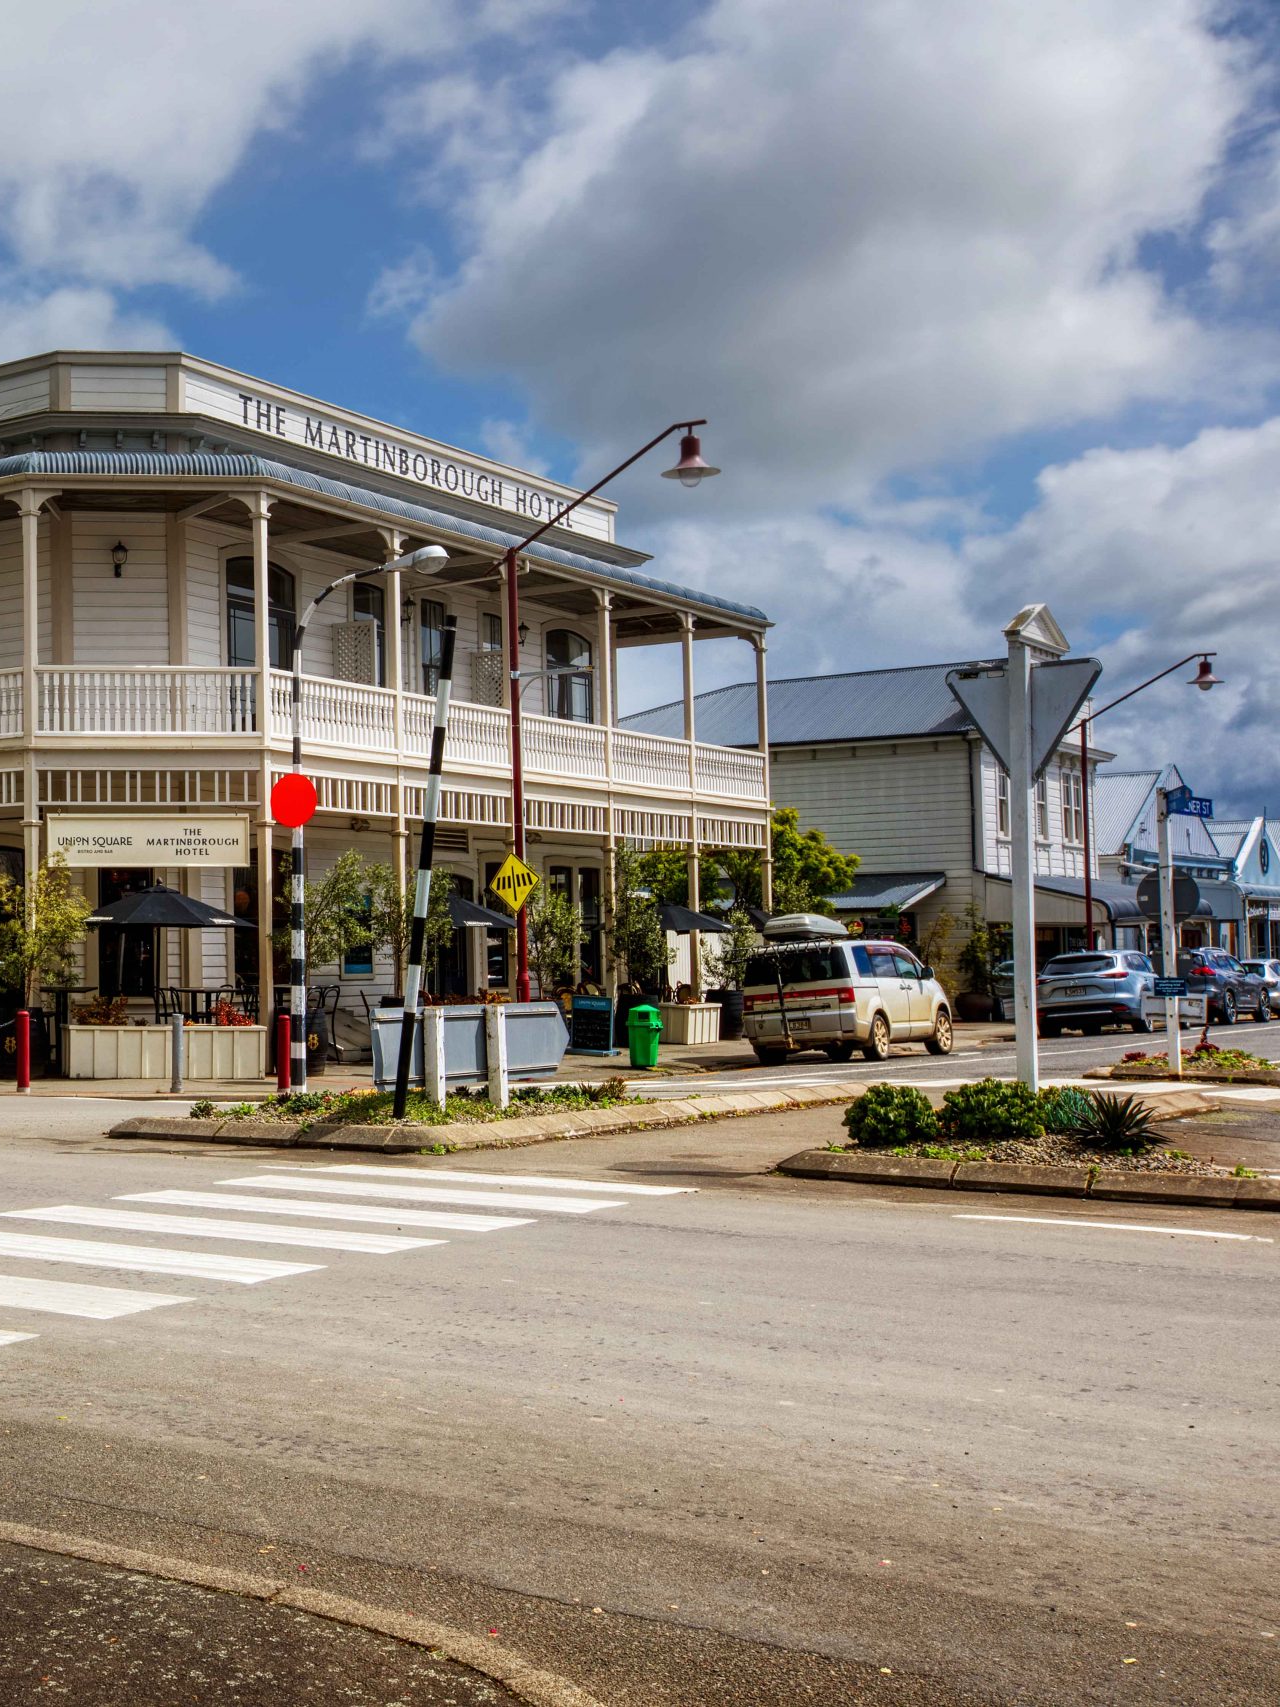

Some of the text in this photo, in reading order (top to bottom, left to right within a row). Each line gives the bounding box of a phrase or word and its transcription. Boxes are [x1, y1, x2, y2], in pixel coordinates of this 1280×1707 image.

[239, 393, 573, 530] THE MARTINBOROUGH HOTEL
[1202, 801, 1210, 815] ST
[183, 828, 202, 836] THE
[92, 836, 133, 848] SQUARE
[146, 838, 239, 846] MARTINBOROUGH
[175, 848, 210, 856] HOTEL
